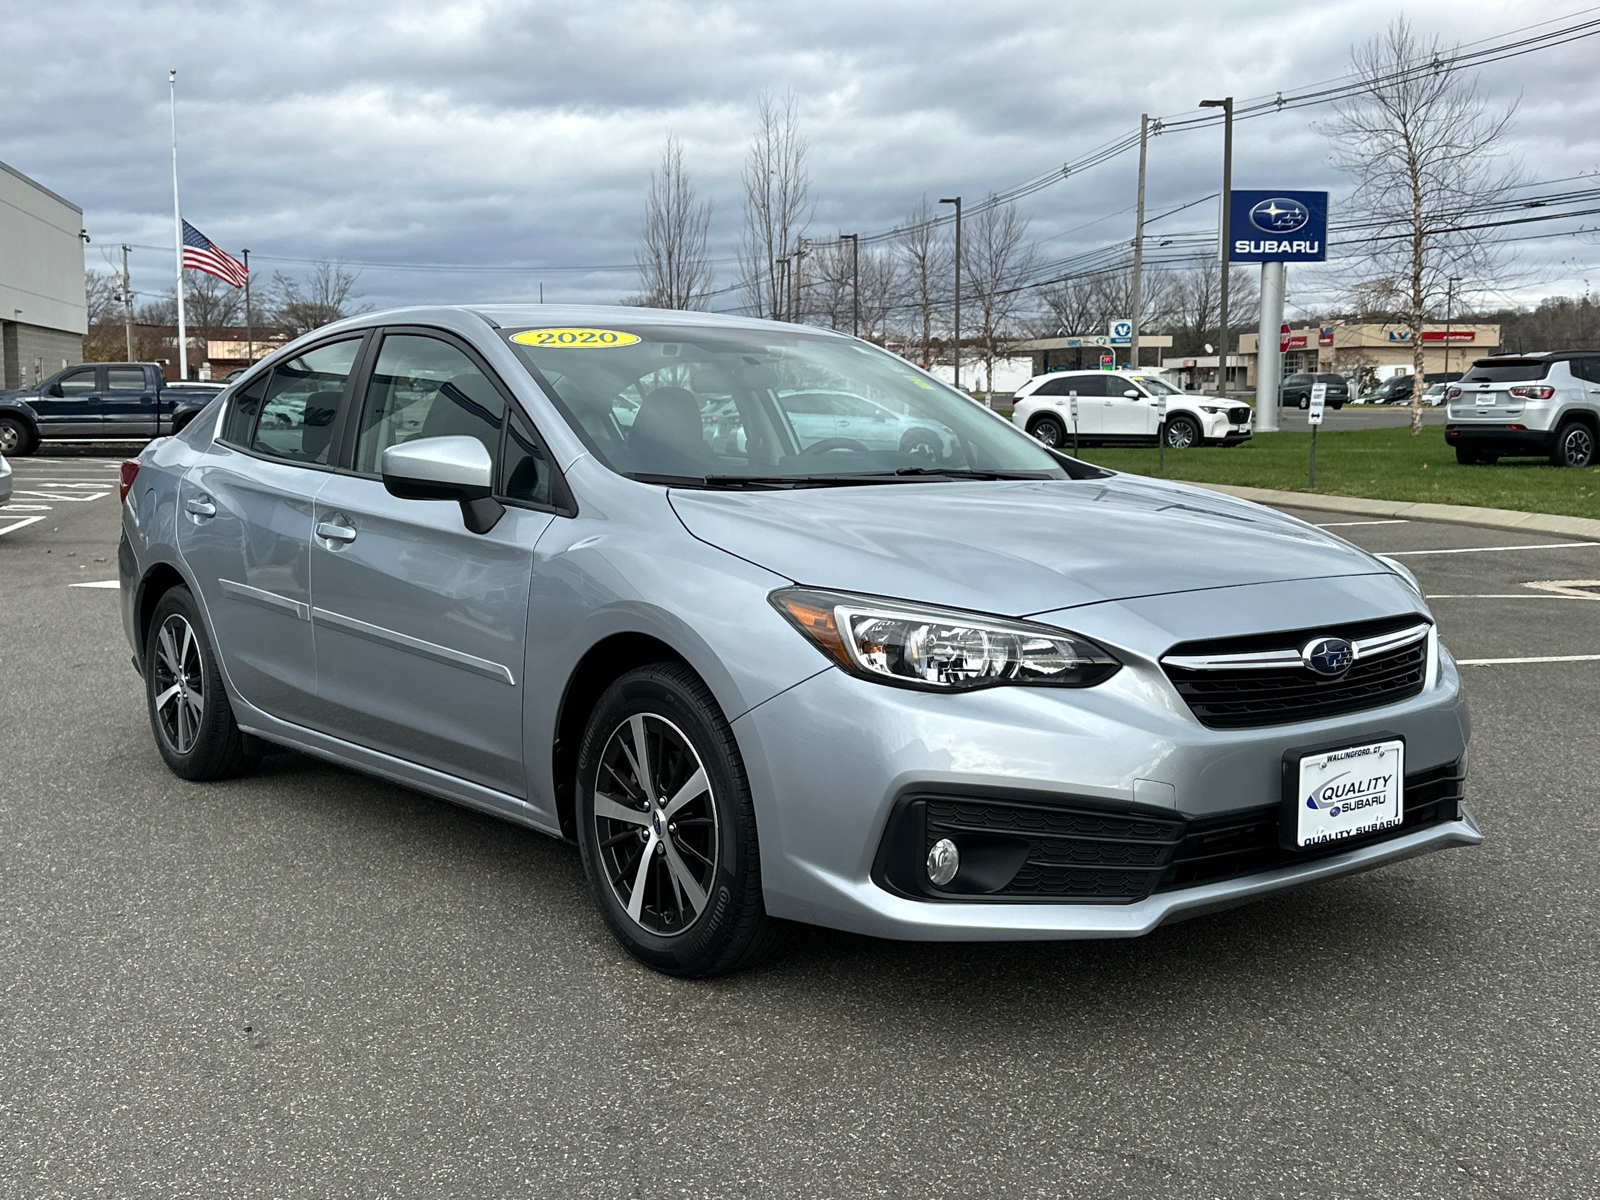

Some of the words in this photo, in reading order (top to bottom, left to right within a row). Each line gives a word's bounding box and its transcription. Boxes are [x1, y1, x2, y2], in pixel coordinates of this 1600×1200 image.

[1235, 240, 1319, 254] SUBARU
[537, 332, 618, 344] 2020
[1373, 746, 1382, 754] CT
[1322, 774, 1392, 801] QUALITY
[1341, 795, 1386, 813] SUBARU
[1304, 828, 1352, 846] QUALITY
[1356, 818, 1401, 835] SUBARU
